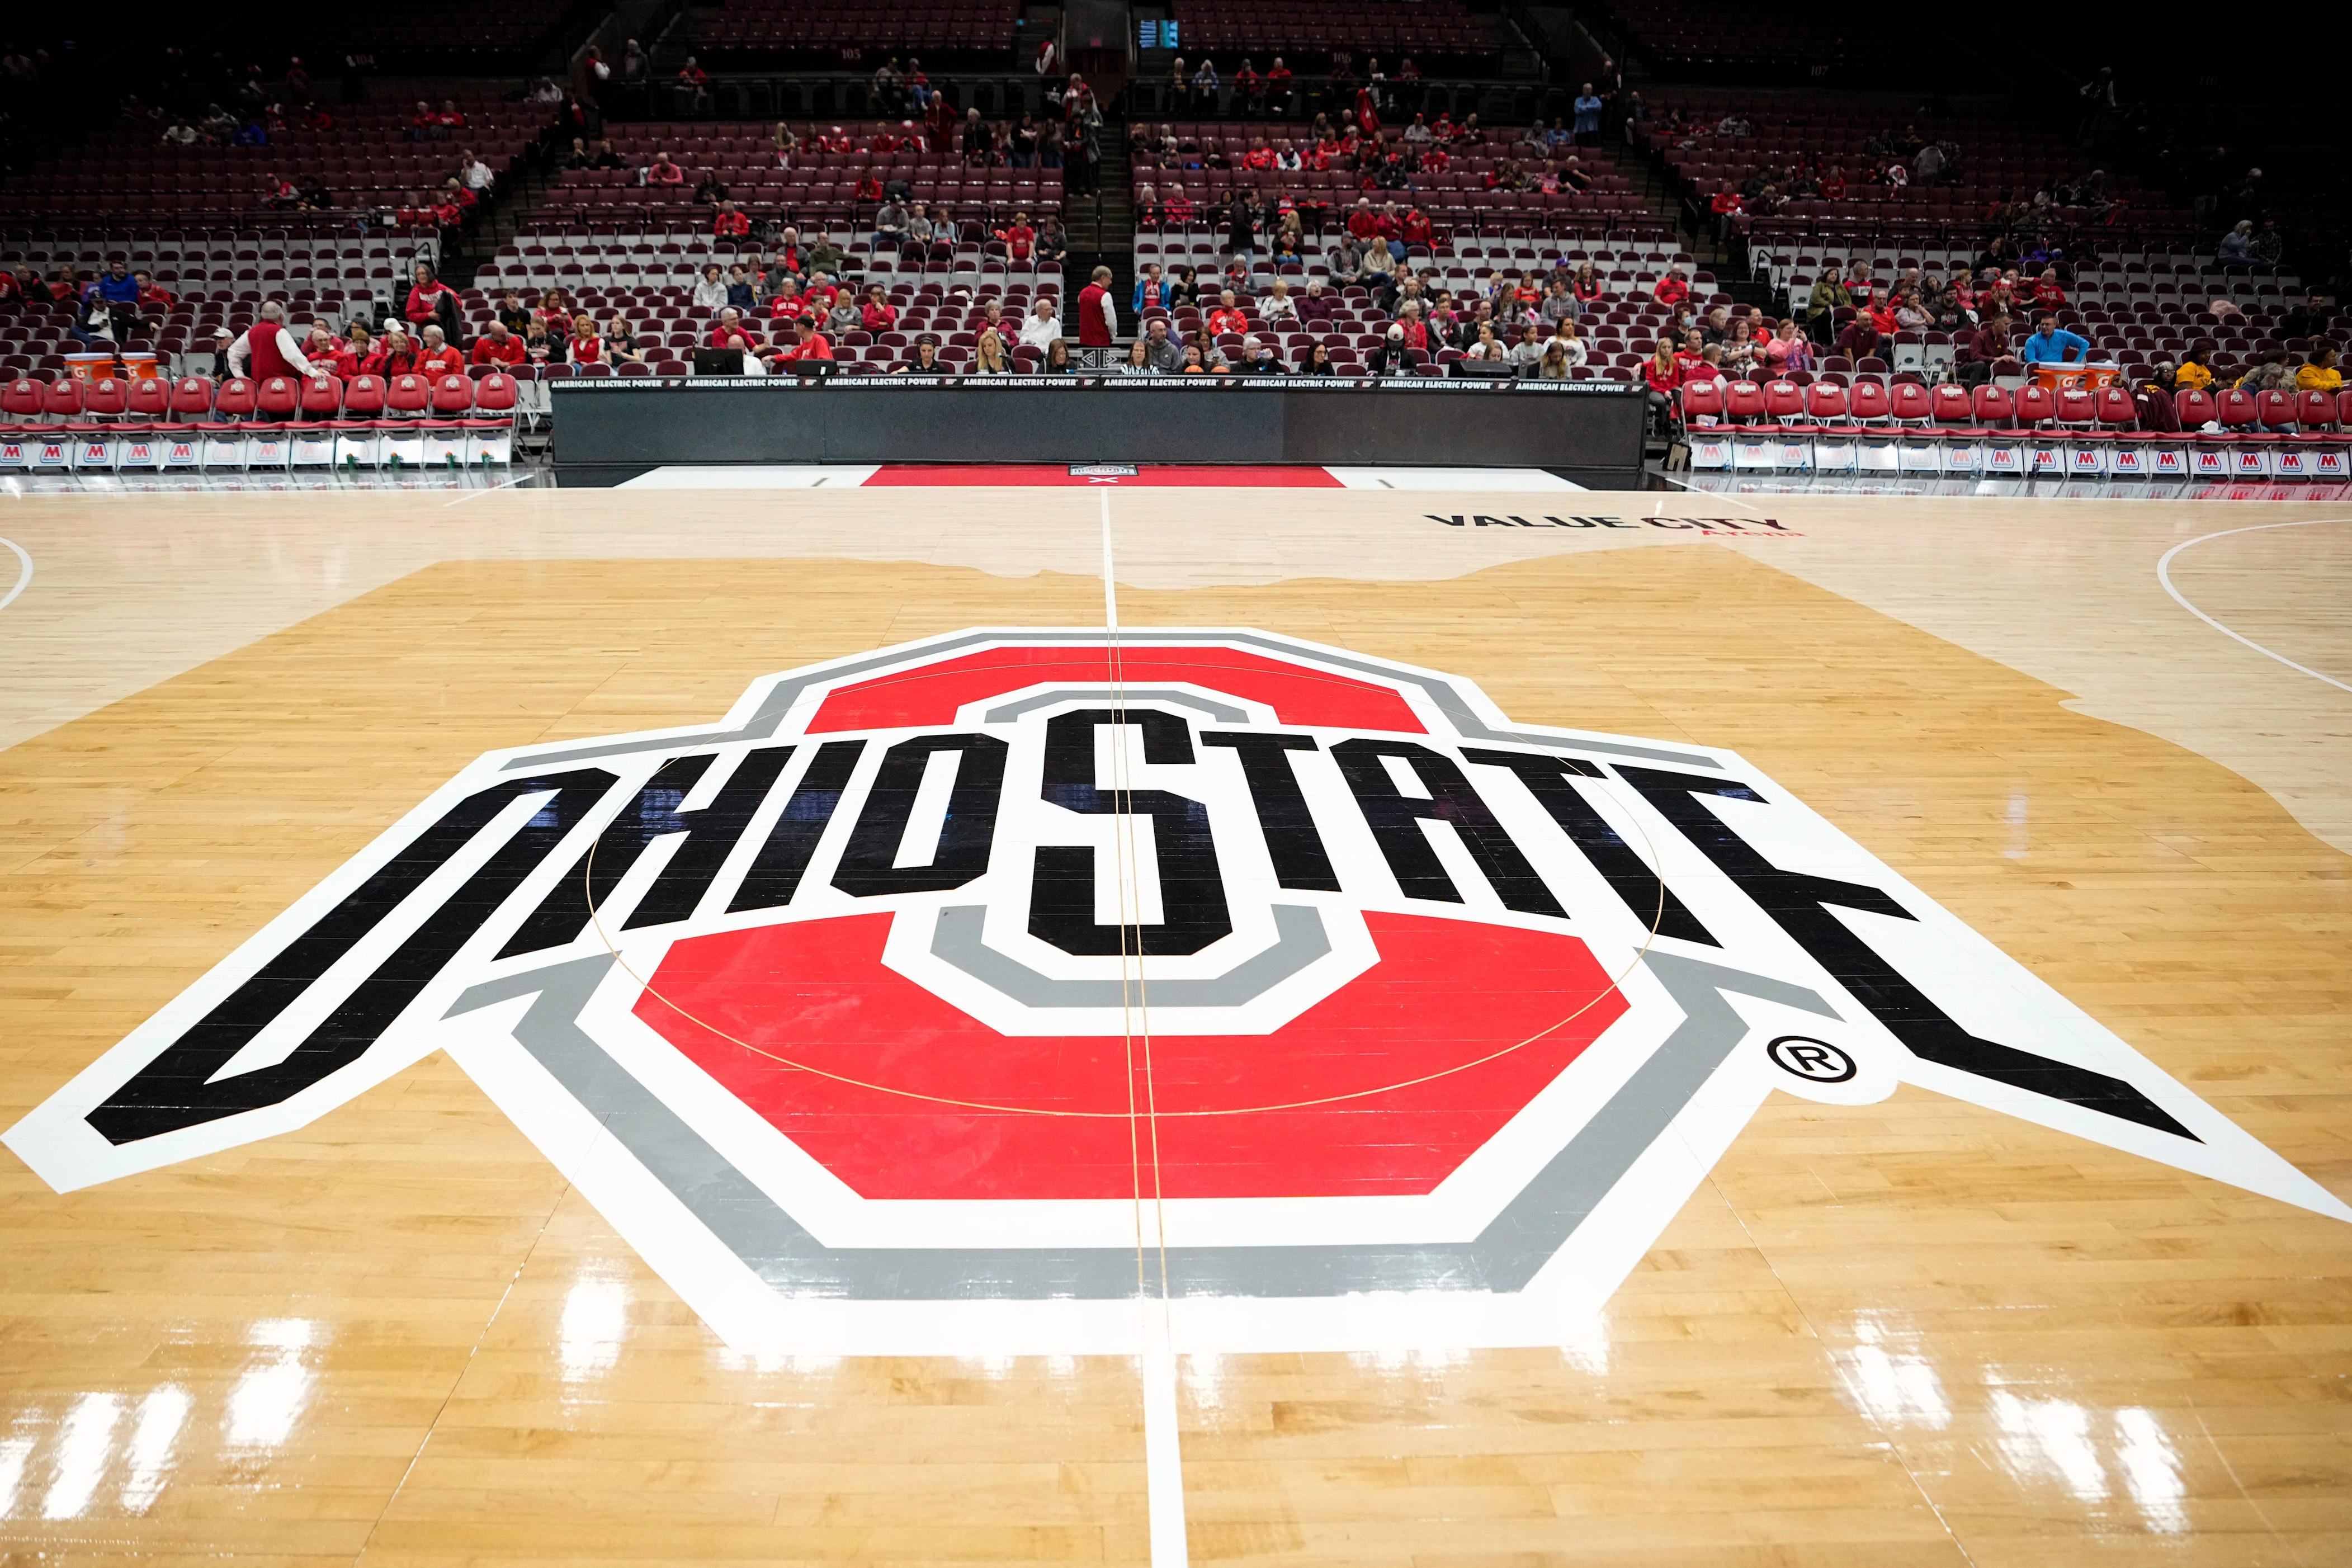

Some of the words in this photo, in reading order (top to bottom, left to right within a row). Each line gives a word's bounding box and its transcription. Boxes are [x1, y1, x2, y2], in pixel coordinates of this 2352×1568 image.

[842, 48, 862, 60] 105
[1333, 52, 1352, 63] 106
[1811, 65, 1830, 77] 107
[74, 367, 86, 379] G
[127, 366, 137, 377] G
[2062, 376, 2074, 387] G
[2098, 376, 2109, 387] G
[3, 446, 20, 458] M
[44, 446, 61, 458] M
[87, 446, 105, 457] M
[131, 446, 148, 457] M
[173, 445, 191, 457] M
[1995, 451, 2011, 462] M
[2037, 452, 2053, 463] M
[2079, 453, 2095, 464] M
[2120, 454, 2136, 465] M
[2160, 454, 2176, 465] M
[2202, 455, 2218, 466] M
[2242, 455, 2259, 466] M
[2283, 455, 2300, 466] M
[2321, 455, 2337, 466] M
[1422, 514, 1641, 528] VALUE
[1640, 518, 1791, 530] CITY
[84, 733, 1009, 1145] OHIO
[1028, 709, 2206, 1144] STATE
